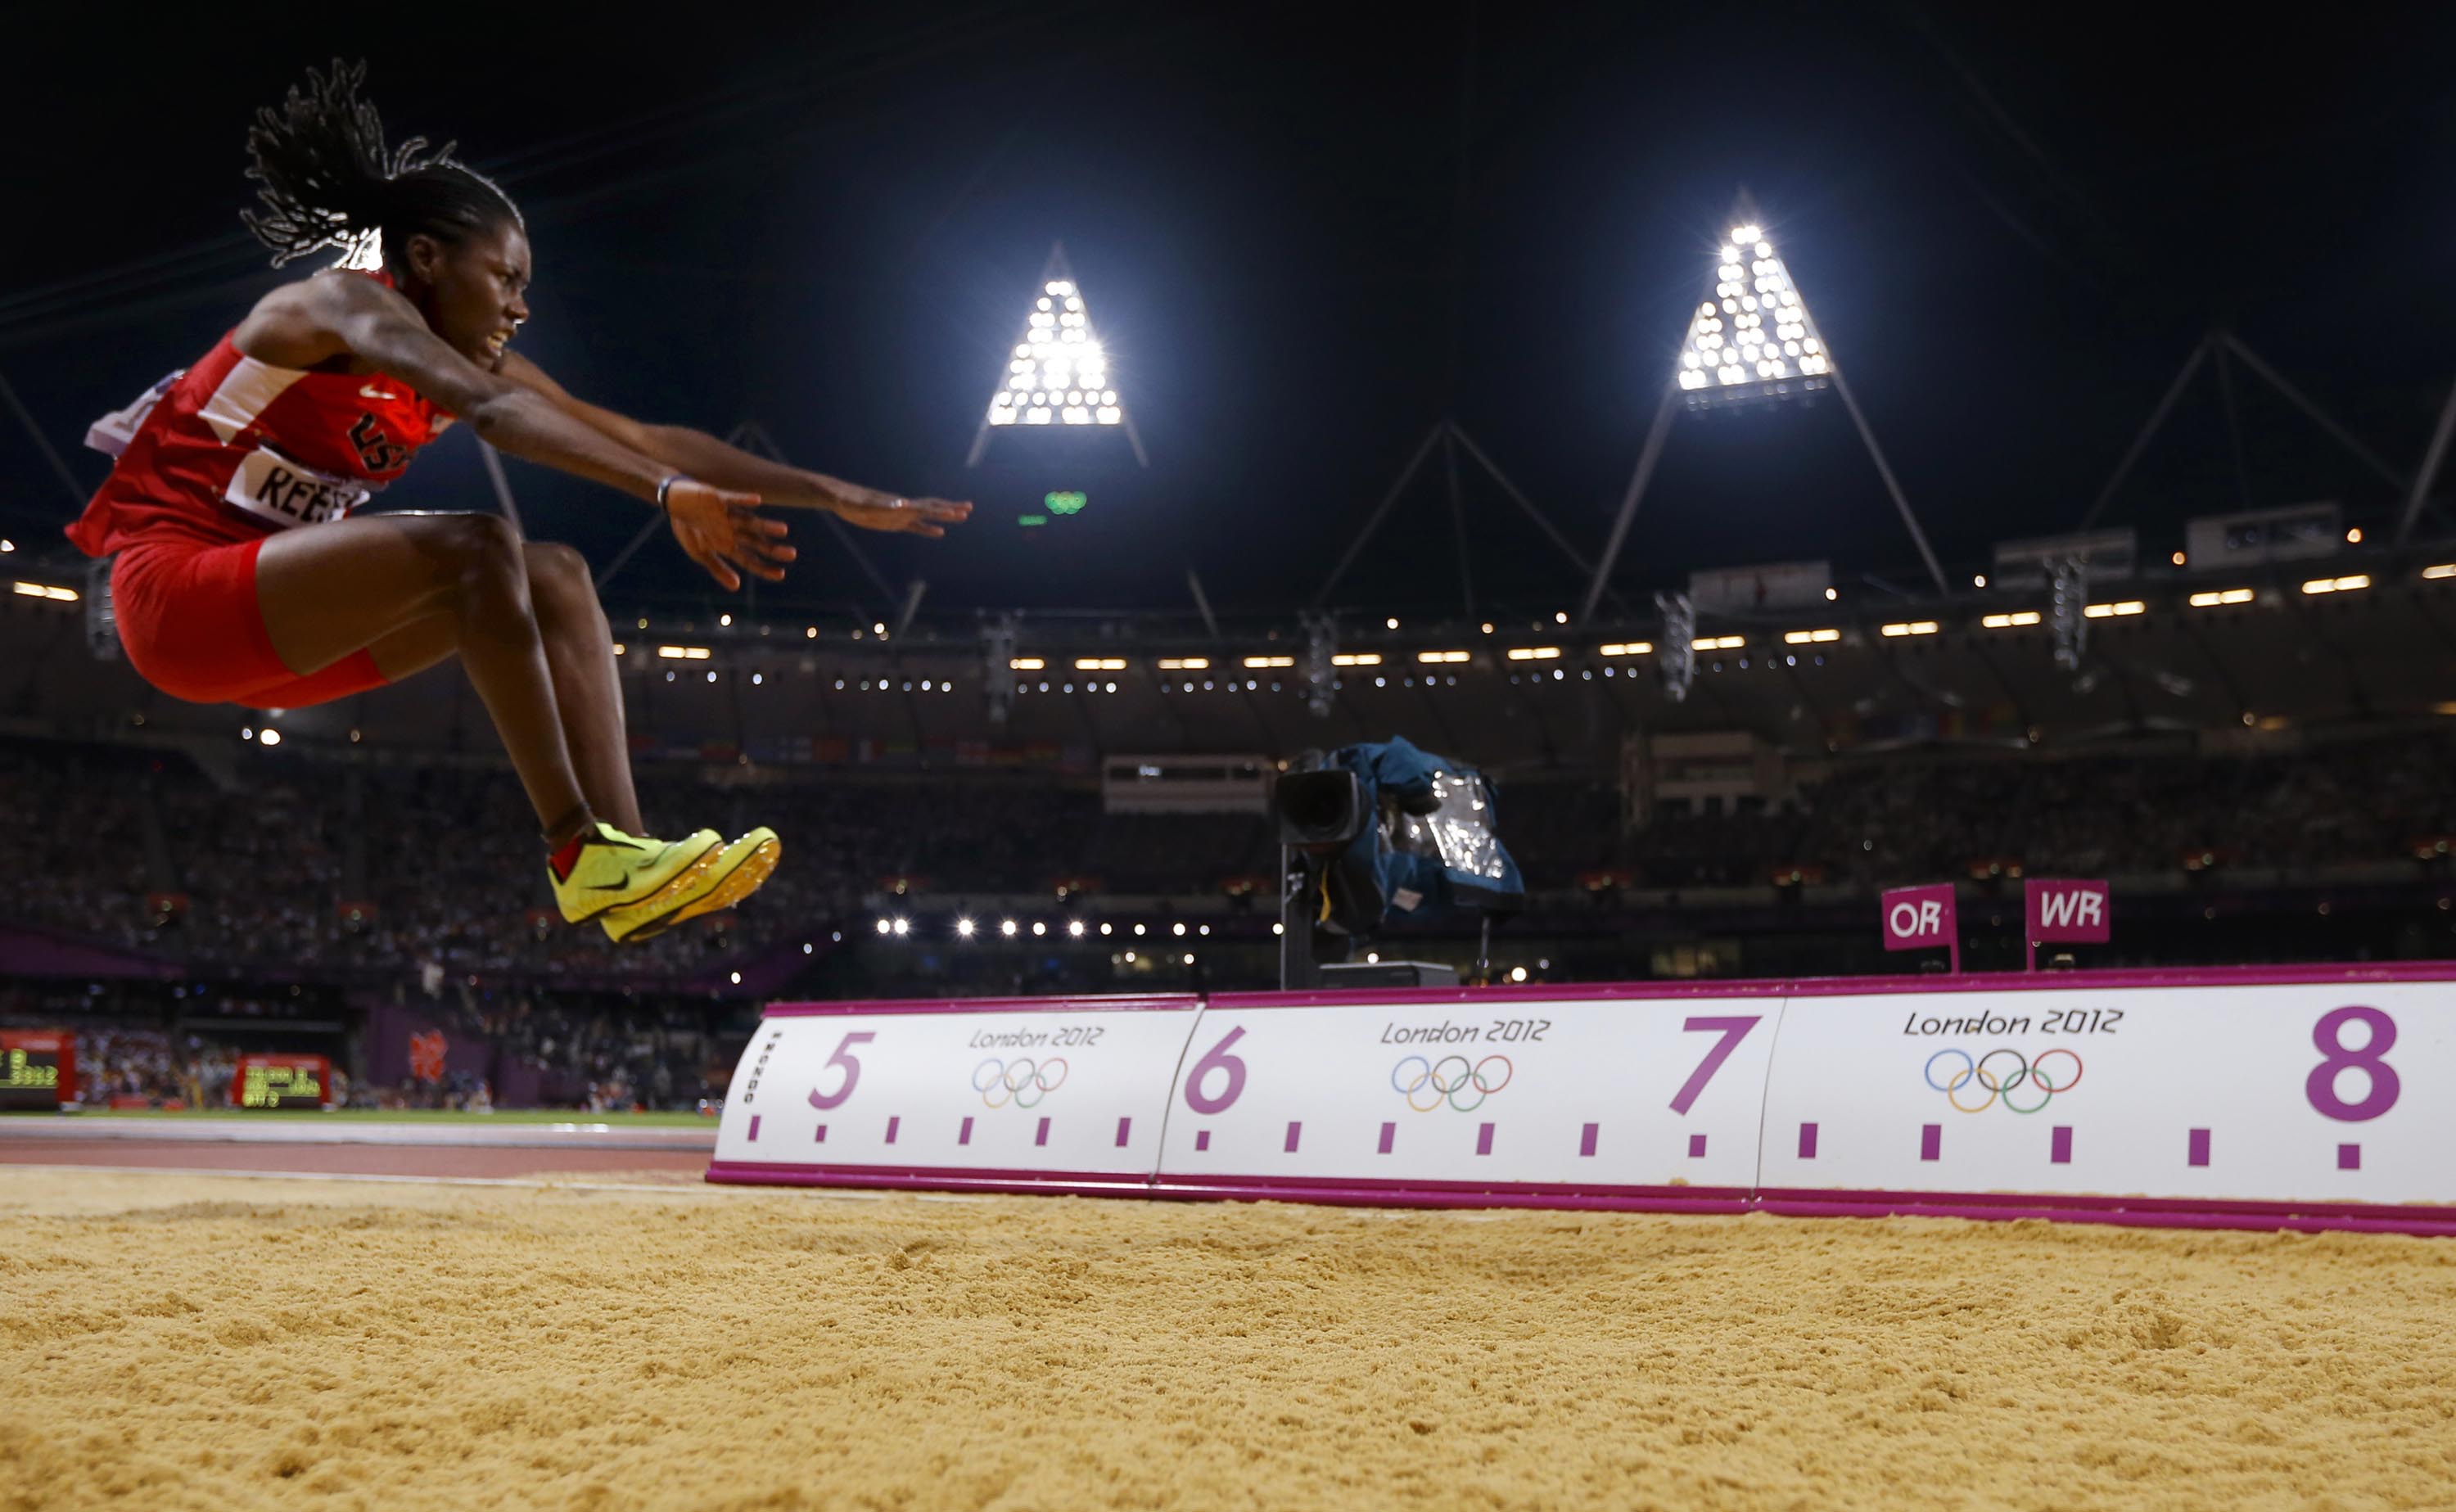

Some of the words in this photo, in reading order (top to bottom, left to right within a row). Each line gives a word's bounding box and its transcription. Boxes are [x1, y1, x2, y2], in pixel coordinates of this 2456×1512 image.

[1889, 900, 1942, 938] OR
[2041, 890, 2103, 928] WR
[969, 1027, 1048, 1049] London
[1051, 1027, 1104, 1047] 2012
[1380, 1020, 1480, 1045] London
[1485, 1019, 1551, 1042] 2012
[1903, 1009, 2030, 1036] London
[2040, 1009, 2124, 1034] 2012
[807, 1031, 877, 1110] 5
[1185, 1025, 1247, 1115] 6
[1668, 1015, 1763, 1116] 7
[2305, 1005, 2400, 1122] 8
